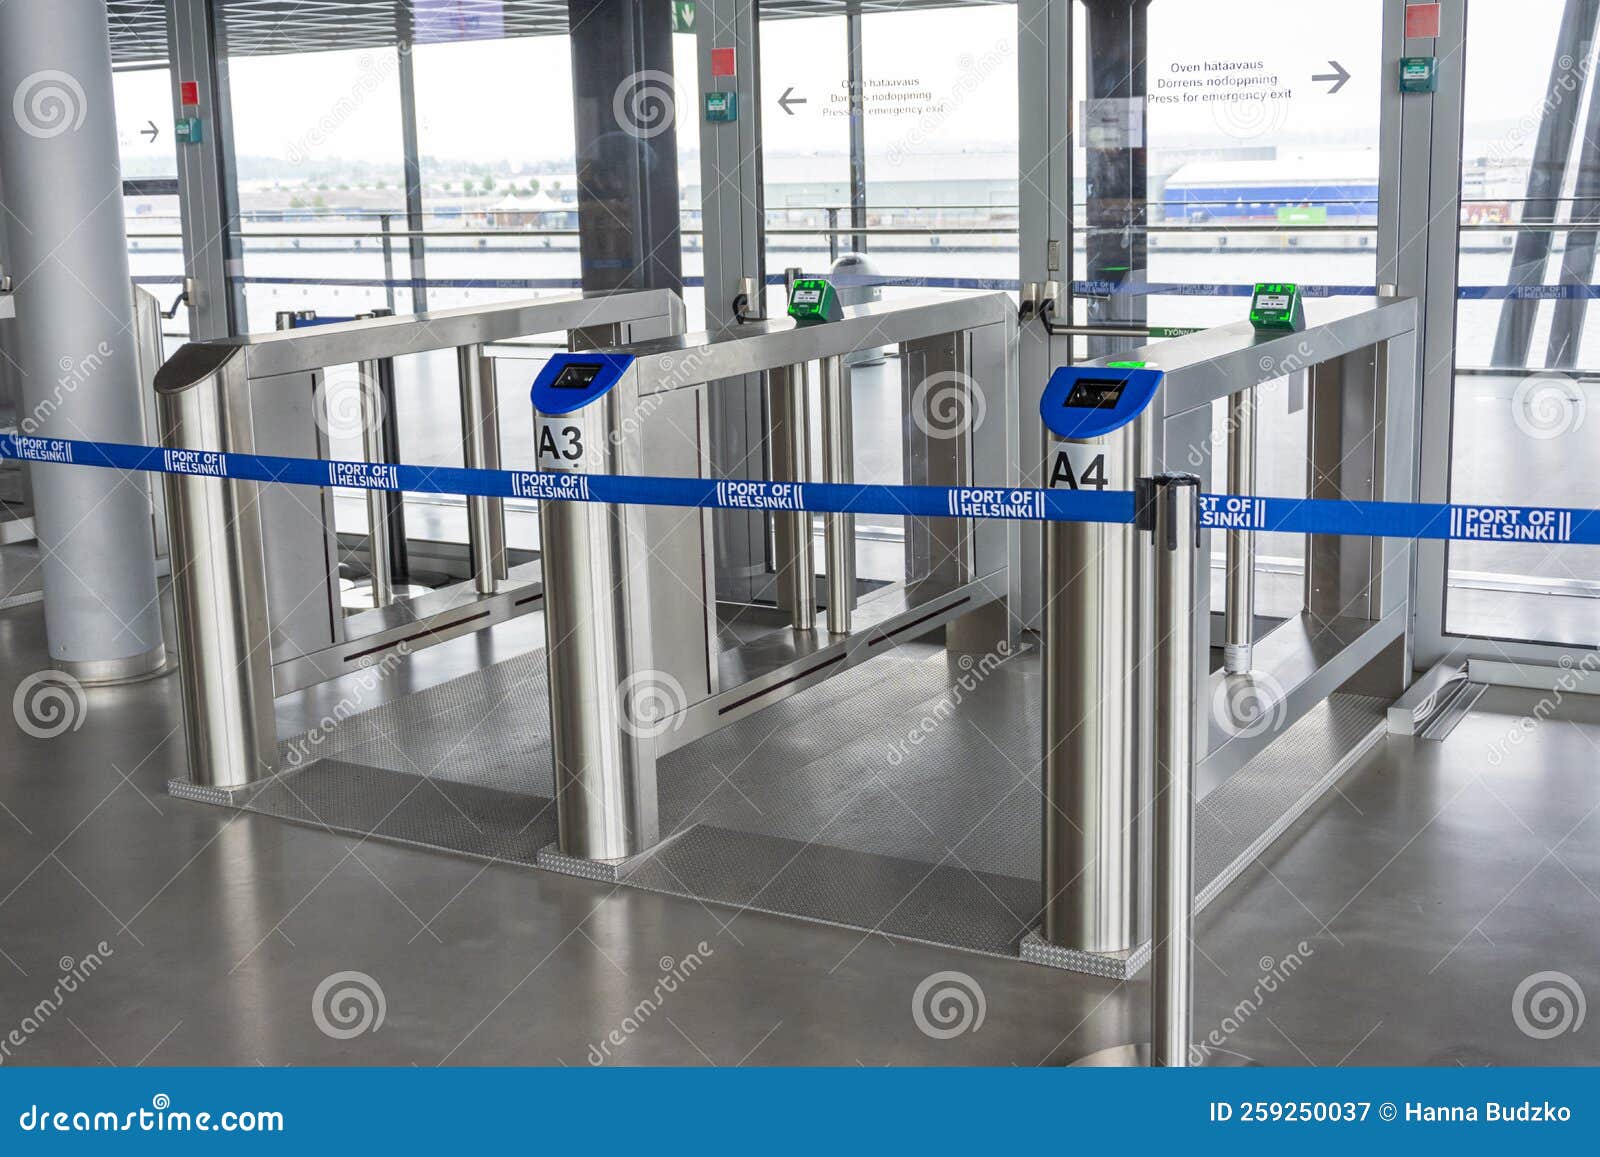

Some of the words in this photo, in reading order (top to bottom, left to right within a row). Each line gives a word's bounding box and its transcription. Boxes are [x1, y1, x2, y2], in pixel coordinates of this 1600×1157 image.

[1170, 62, 1201, 73] Oven
[1147, 93, 1180, 104] Press
[1183, 92, 1199, 102] for
[1202, 90, 1267, 102] emergency
[1270, 89, 1292, 99] exit
[868, 104, 923, 115] emergency
[22, 438, 48, 450] PORT
[51, 440, 64, 452] OF
[538, 425, 584, 460] A3
[23, 448, 66, 462] HELSINKI
[172, 451, 200, 463] PORT
[203, 454, 218, 465] OF
[172, 461, 219, 475] HELSINKI
[337, 463, 368, 476] PORT
[372, 465, 388, 477] OF
[1050, 451, 1108, 490] A4
[338, 475, 389, 488] HELSINKI
[521, 473, 556, 486] PORT
[560, 475, 578, 487] OF
[522, 486, 579, 499] HELSINKI
[727, 482, 766, 496] PORT
[771, 484, 791, 496] OF
[728, 495, 793, 509] HELSINKI
[960, 490, 1005, 503] PORT
[1010, 491, 1033, 504] OF
[1199, 496, 1220, 511] RT
[1226, 498, 1252, 512] OF
[961, 503, 1033, 518] HELSINKI
[1466, 508, 1521, 524] PORT
[1528, 510, 1556, 525] OF
[1199, 511, 1251, 527] SINKI
[1465, 523, 1555, 540] HELSINKI
